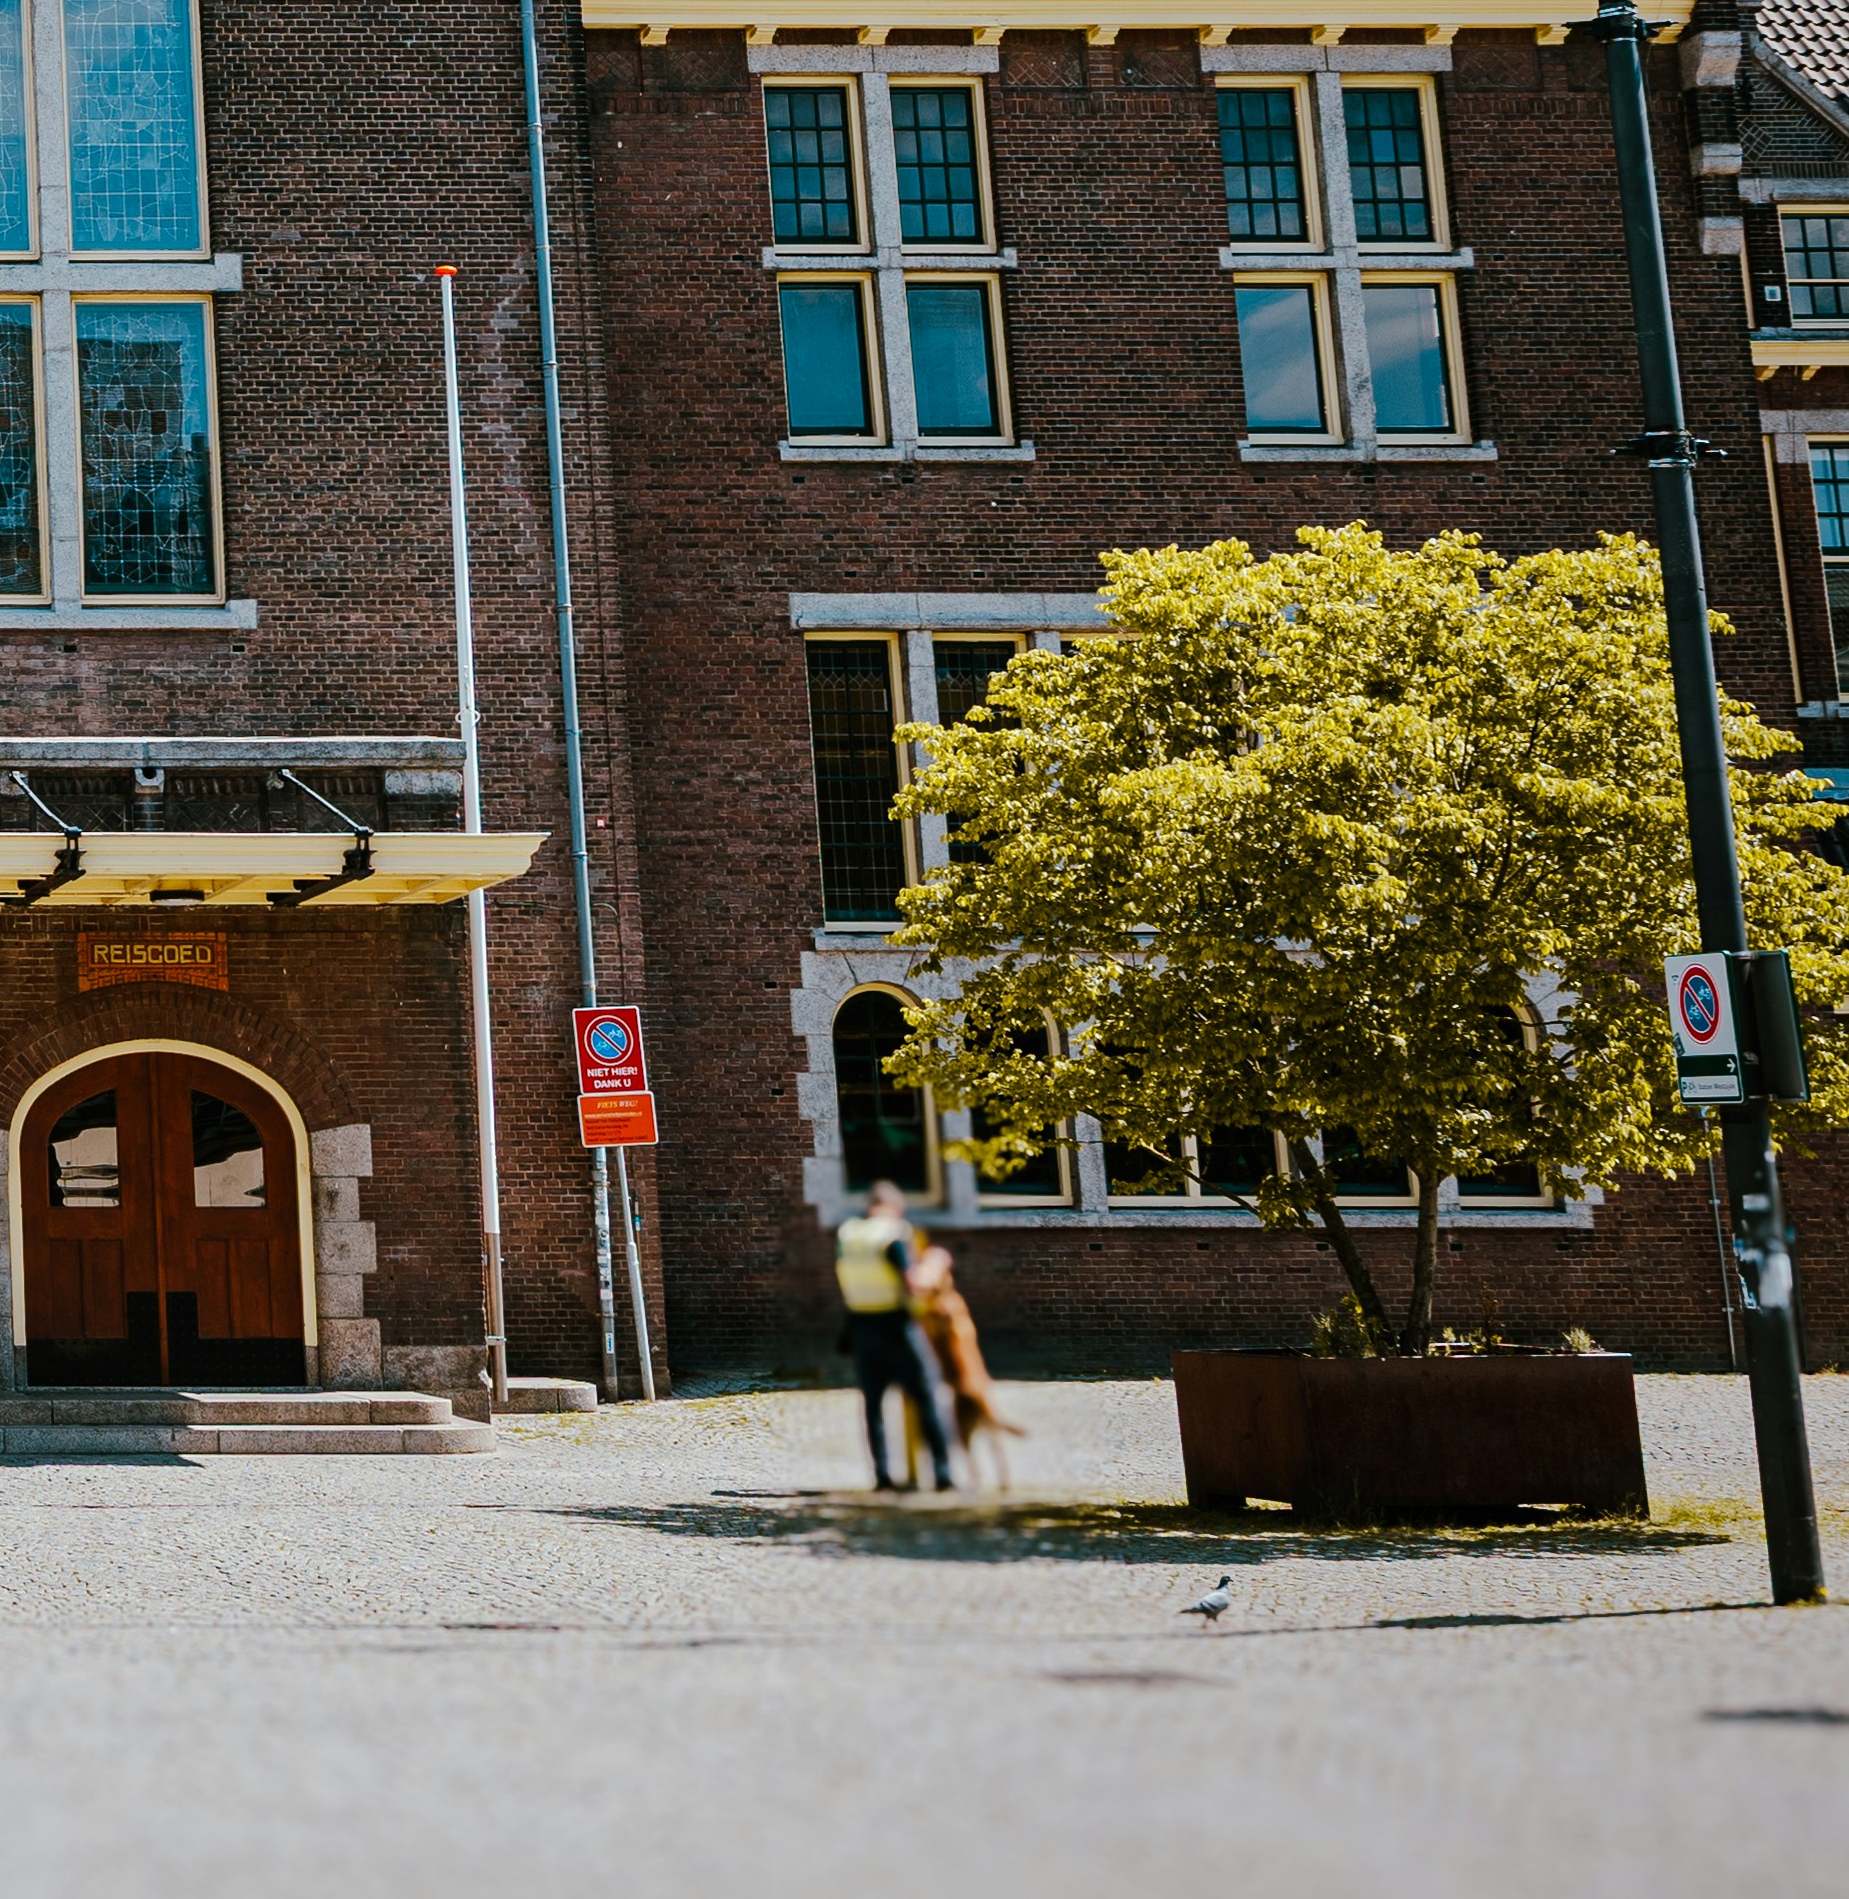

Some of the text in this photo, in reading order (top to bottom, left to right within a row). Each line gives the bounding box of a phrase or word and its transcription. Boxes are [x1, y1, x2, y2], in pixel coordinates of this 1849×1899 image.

[93, 944, 212, 964] REISGOED
[586, 1066, 638, 1077] NIET HIER!
[593, 1078, 632, 1089] DANK U
